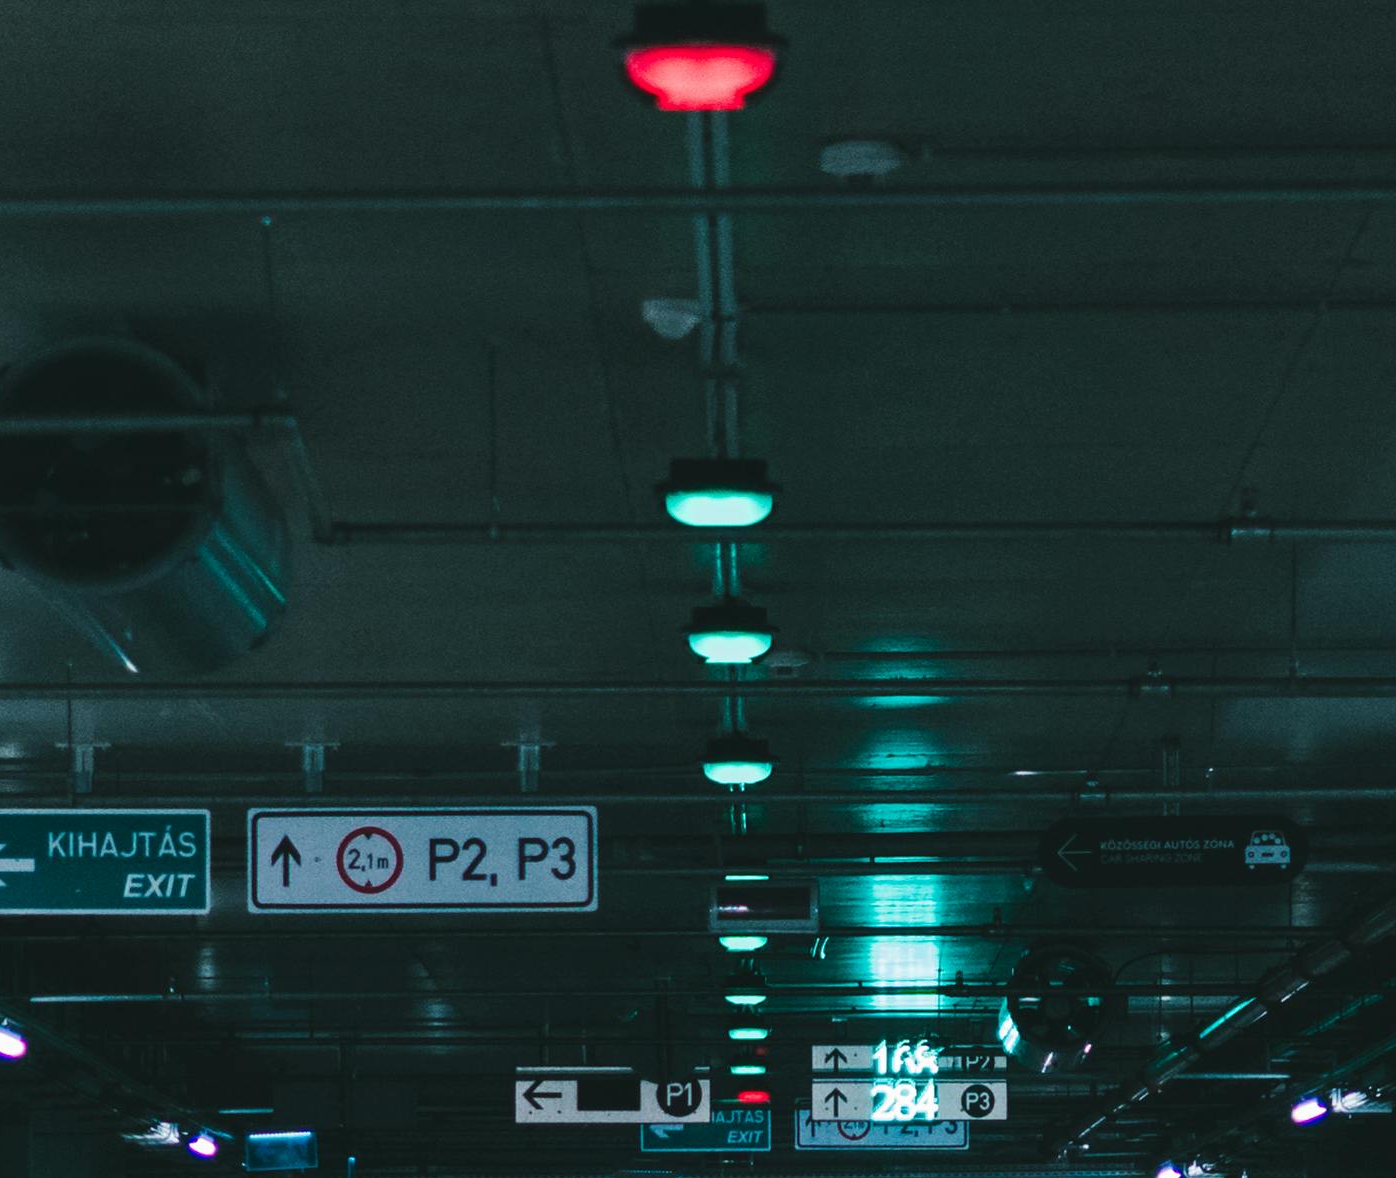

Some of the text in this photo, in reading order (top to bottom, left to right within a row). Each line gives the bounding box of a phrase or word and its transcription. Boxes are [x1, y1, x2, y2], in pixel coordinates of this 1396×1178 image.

[47, 831, 197, 859] KIHAJTÁS
[429, 837, 576, 886] P2, P3
[122, 873, 196, 898] EXIT
[666, 1082, 693, 1107] P1
[870, 1079, 939, 1122] 284
[965, 1092, 990, 1111] P3
[726, 1130, 764, 1144] EXIT
